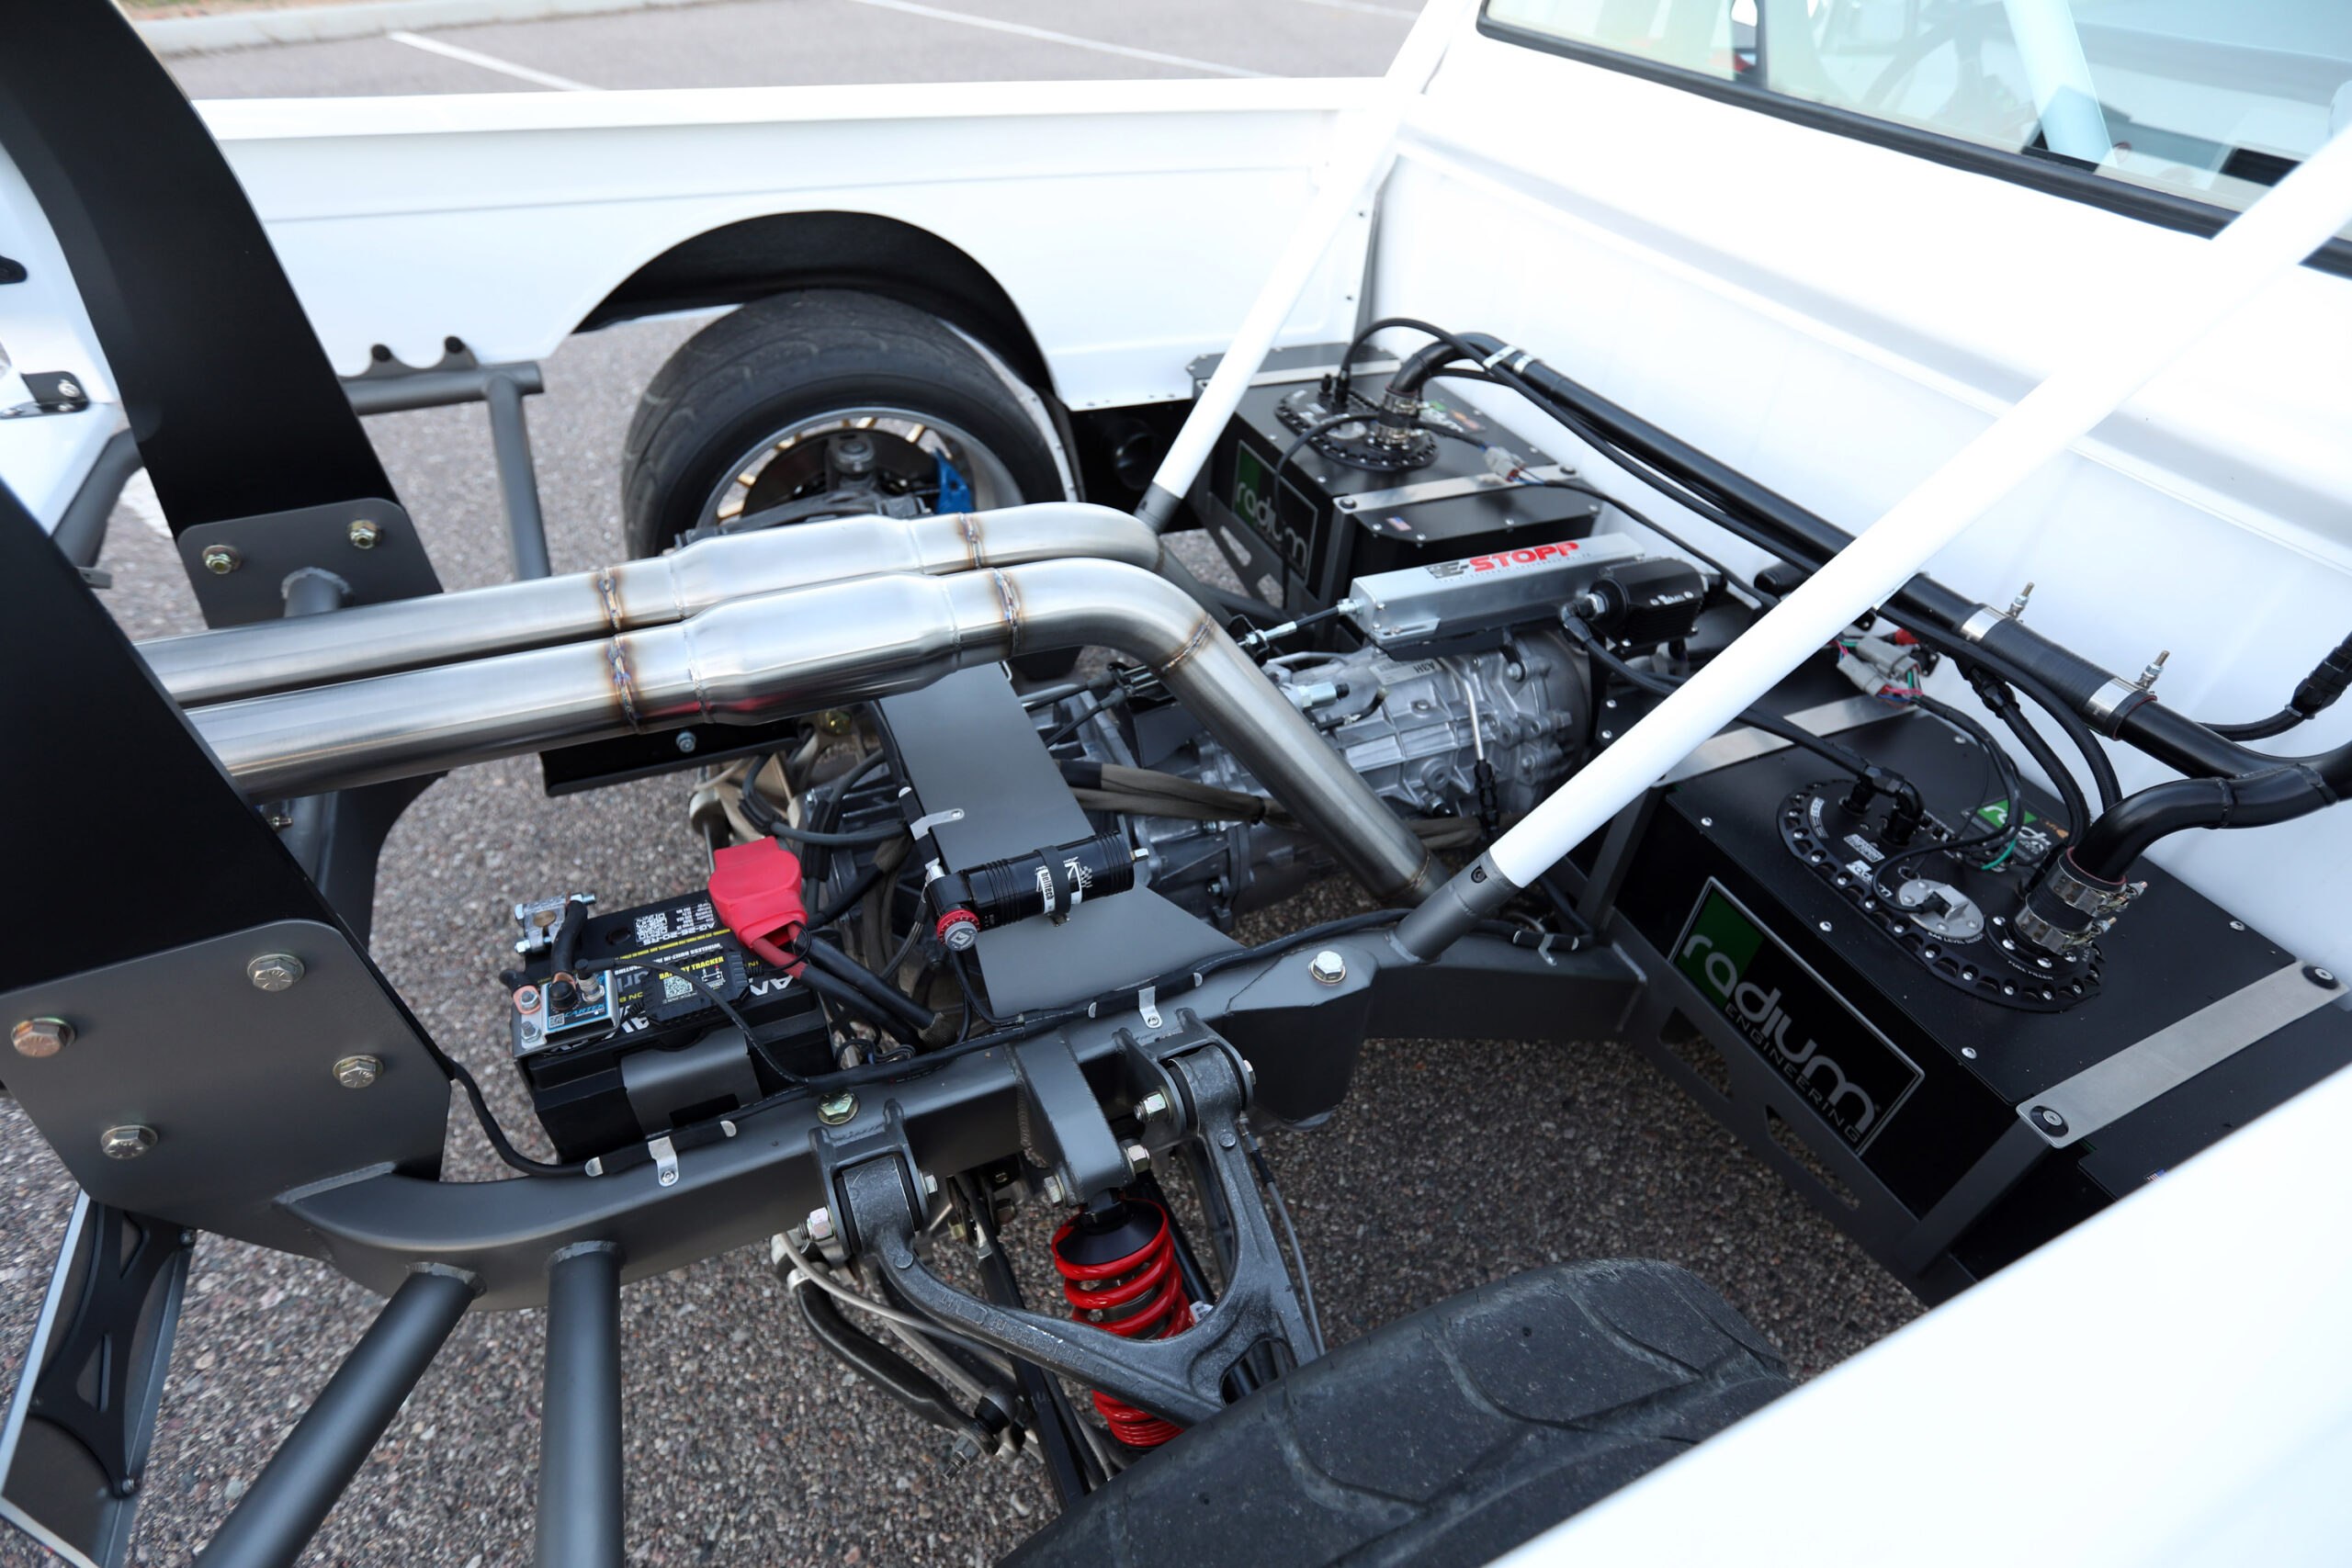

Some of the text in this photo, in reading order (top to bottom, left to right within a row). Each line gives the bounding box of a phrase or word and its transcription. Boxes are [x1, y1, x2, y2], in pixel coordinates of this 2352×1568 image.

[691, 956, 725, 972] TRACKER
[564, 1004, 605, 1018] CARTEK
[1682, 933, 1875, 1135] radium
[1724, 1002, 1861, 1145] ENGINEERING
